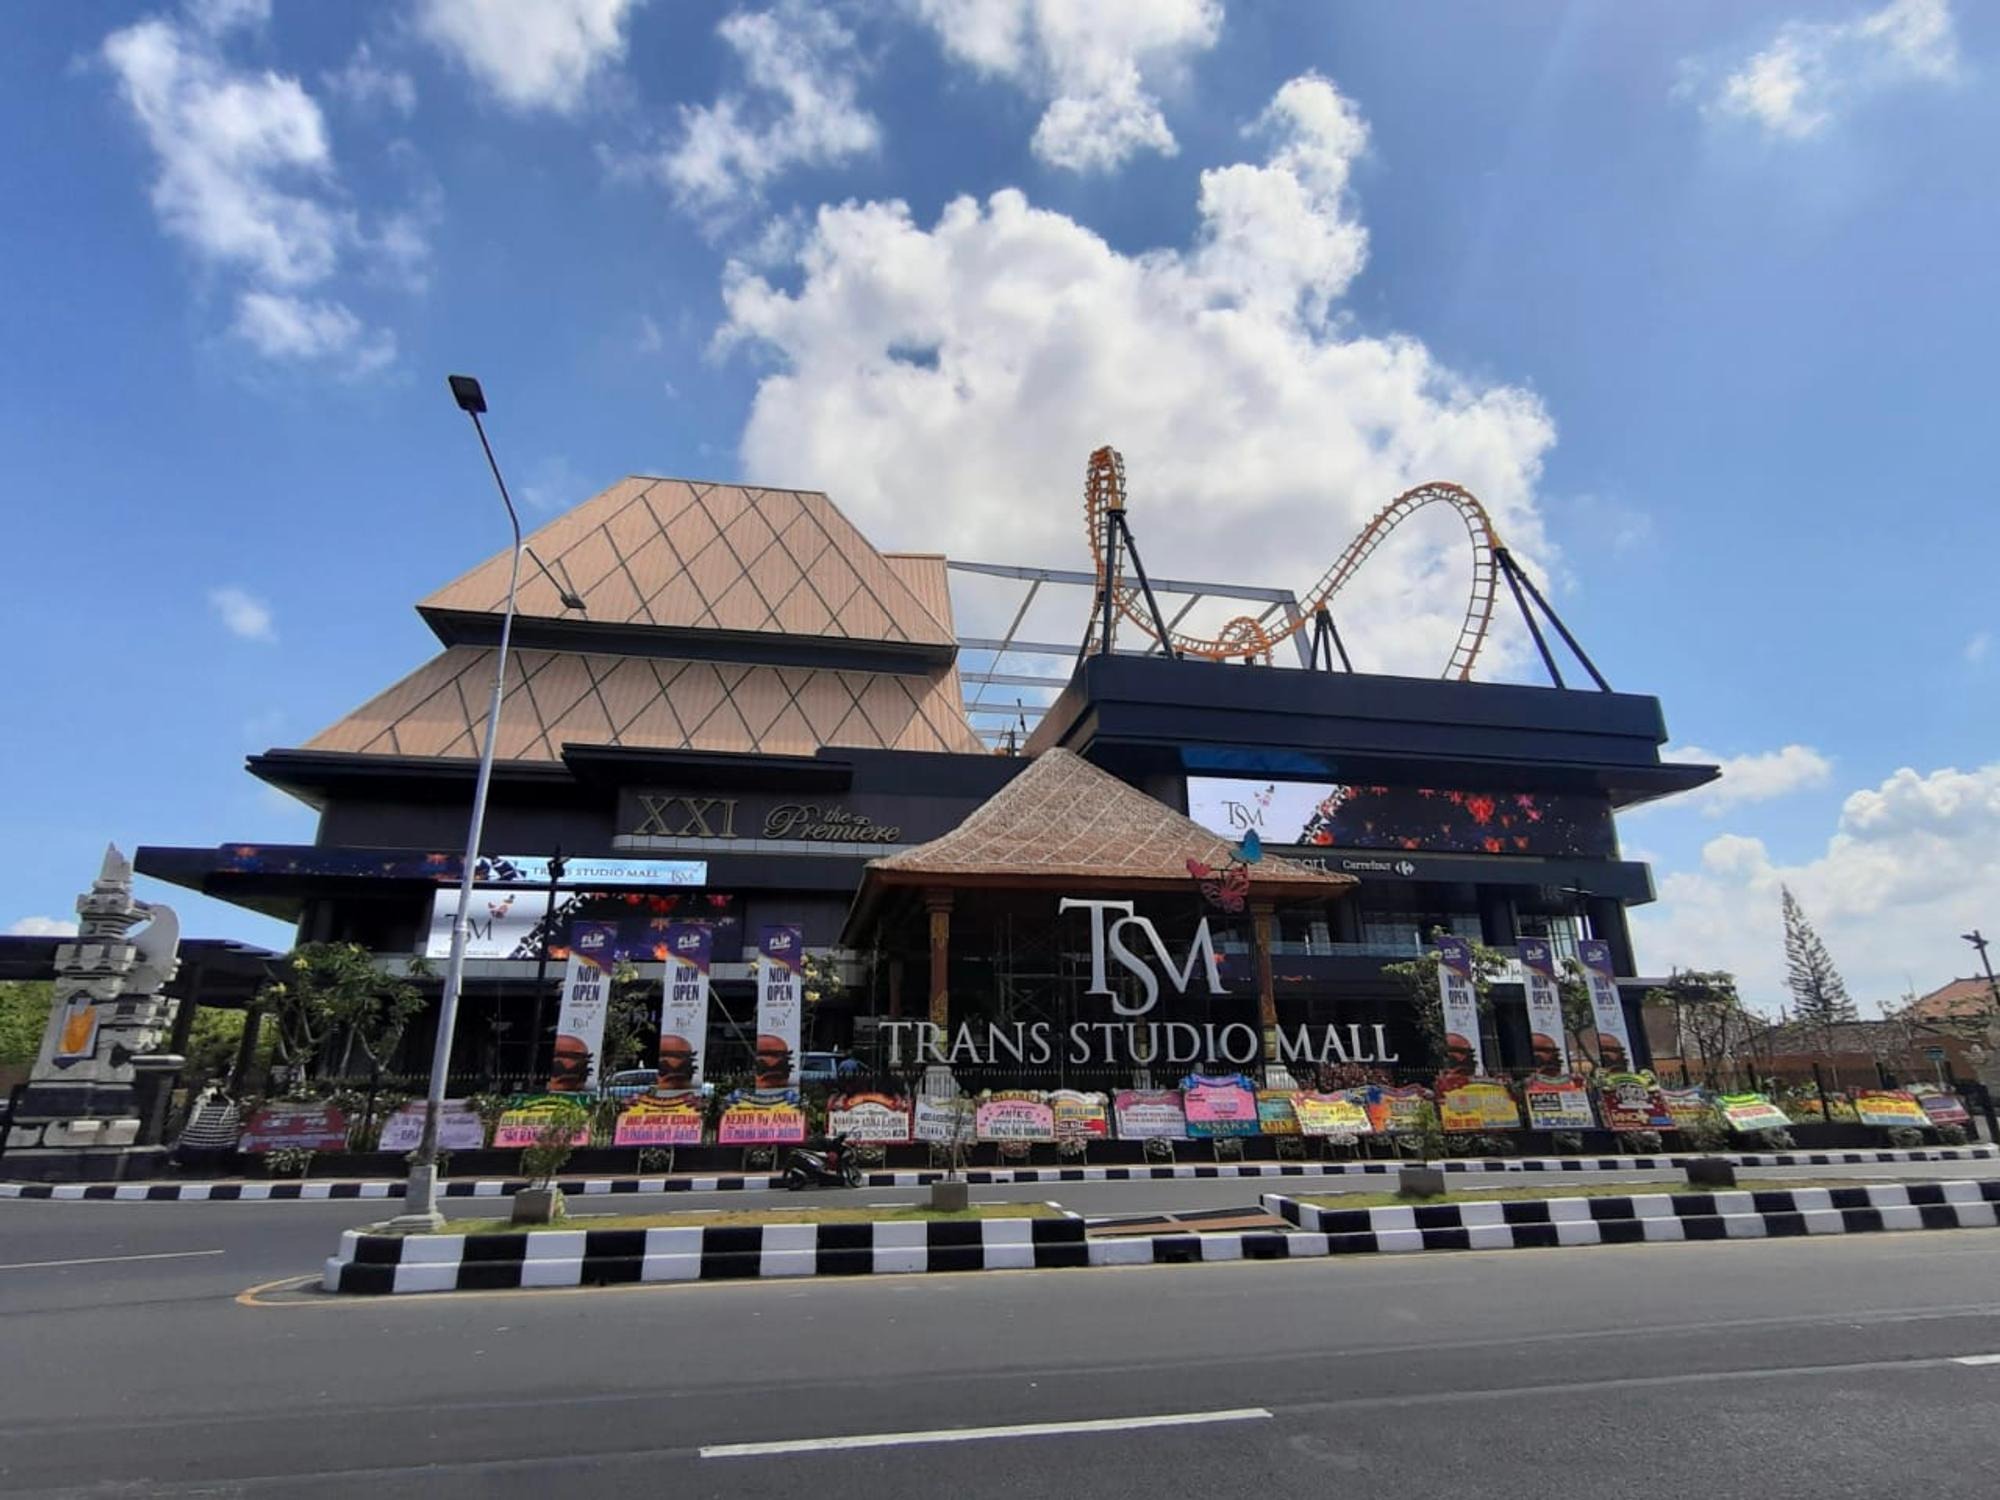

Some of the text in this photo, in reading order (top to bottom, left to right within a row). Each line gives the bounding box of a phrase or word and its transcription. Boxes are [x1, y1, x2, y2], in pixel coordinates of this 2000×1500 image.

[634, 796, 738, 837] XXI
[762, 803, 900, 842] Premiere
[823, 805, 850, 823] the
[1221, 801, 1264, 830] TSM
[576, 866, 623, 878] STUDIO
[626, 868, 660, 878] MALL
[1059, 898, 1231, 1016] TSM
[576, 966, 600, 982] NOW
[675, 967, 699, 982] NOW
[768, 967, 791, 982] NOW
[572, 984, 600, 1001] OPEN
[673, 985, 700, 1001] OPEN
[767, 985, 792, 1001] OPEN
[878, 1022, 1399, 1064] TRANS STUDIO MALL
